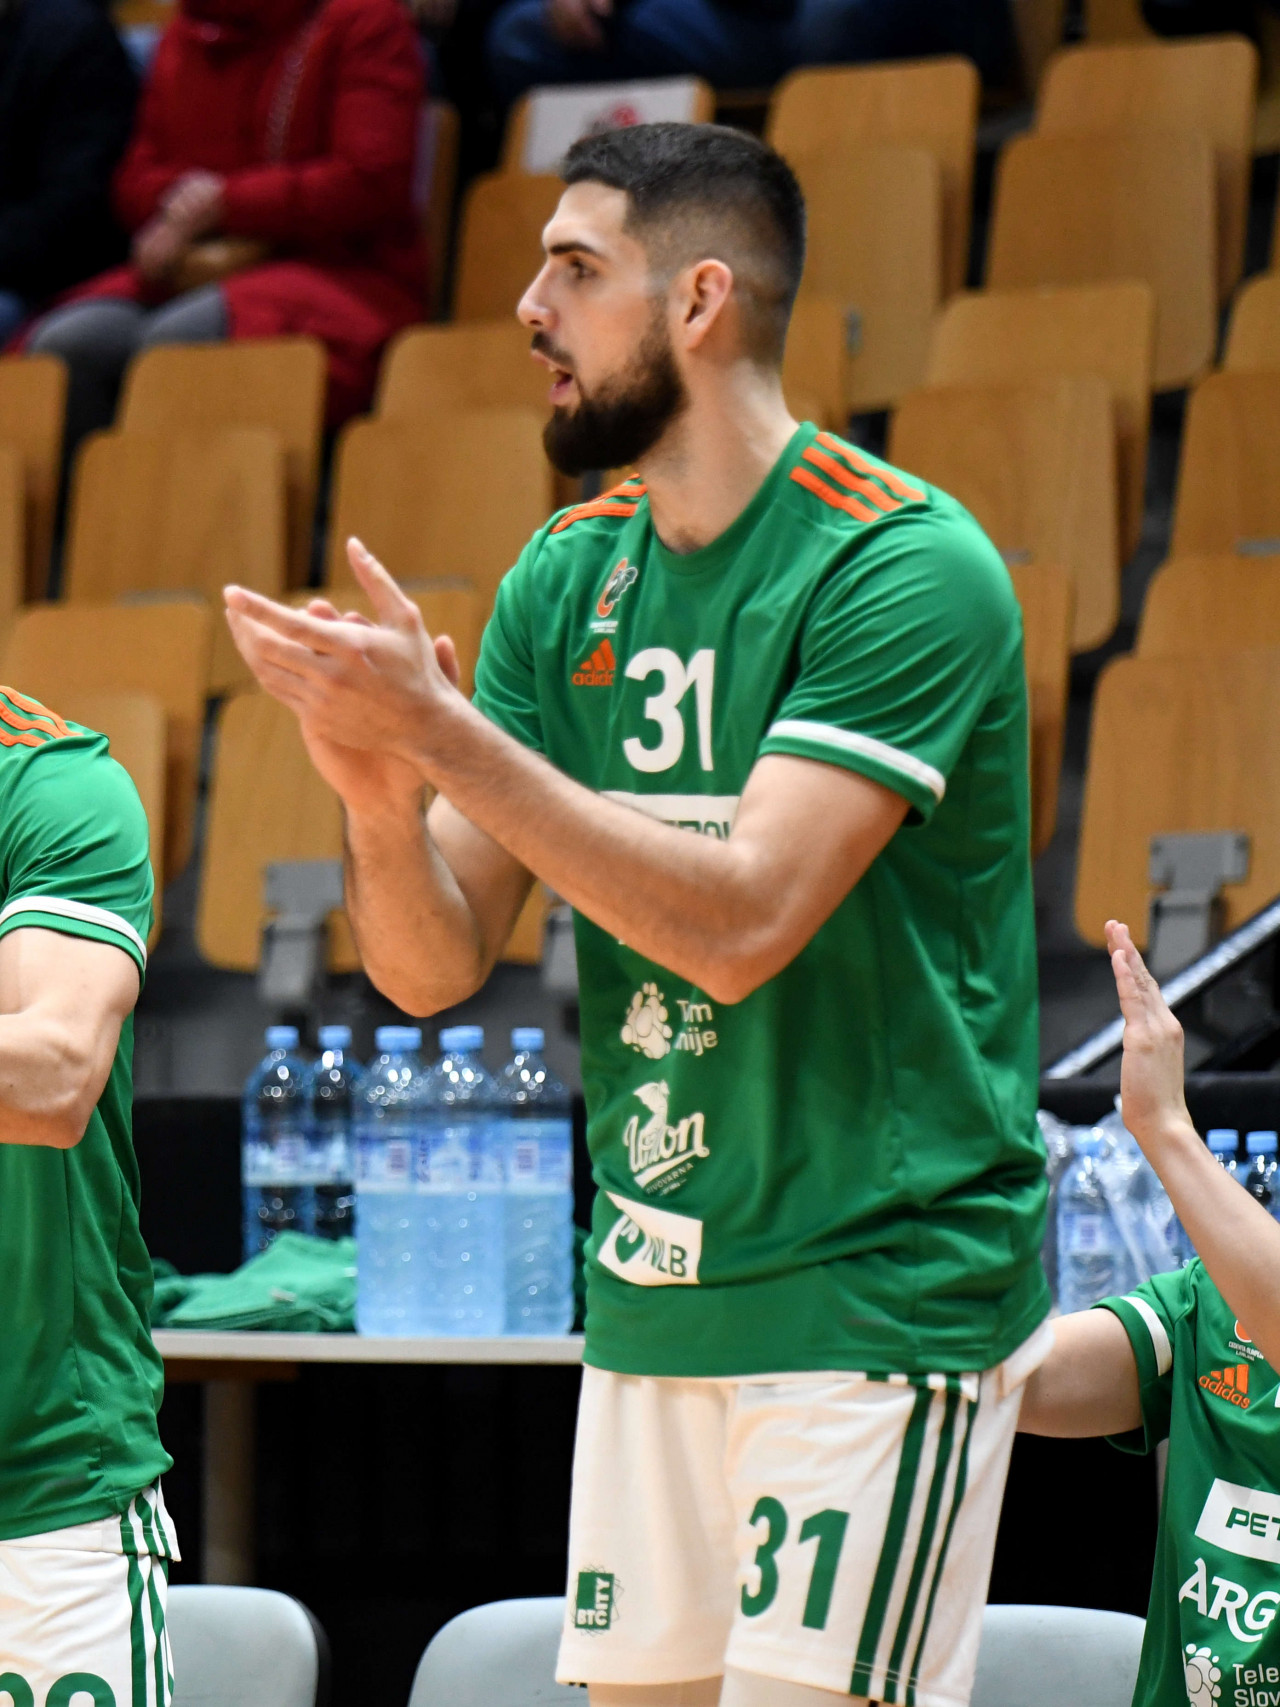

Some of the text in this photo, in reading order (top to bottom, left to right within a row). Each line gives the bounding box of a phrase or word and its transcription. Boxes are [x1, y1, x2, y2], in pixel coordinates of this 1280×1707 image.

[623, 647, 715, 773] 31
[642, 1235, 688, 1278] NLB
[1198, 1375, 1250, 1409] adidas
[741, 1496, 850, 1631] 31
[576, 1608, 608, 1626] BTC
